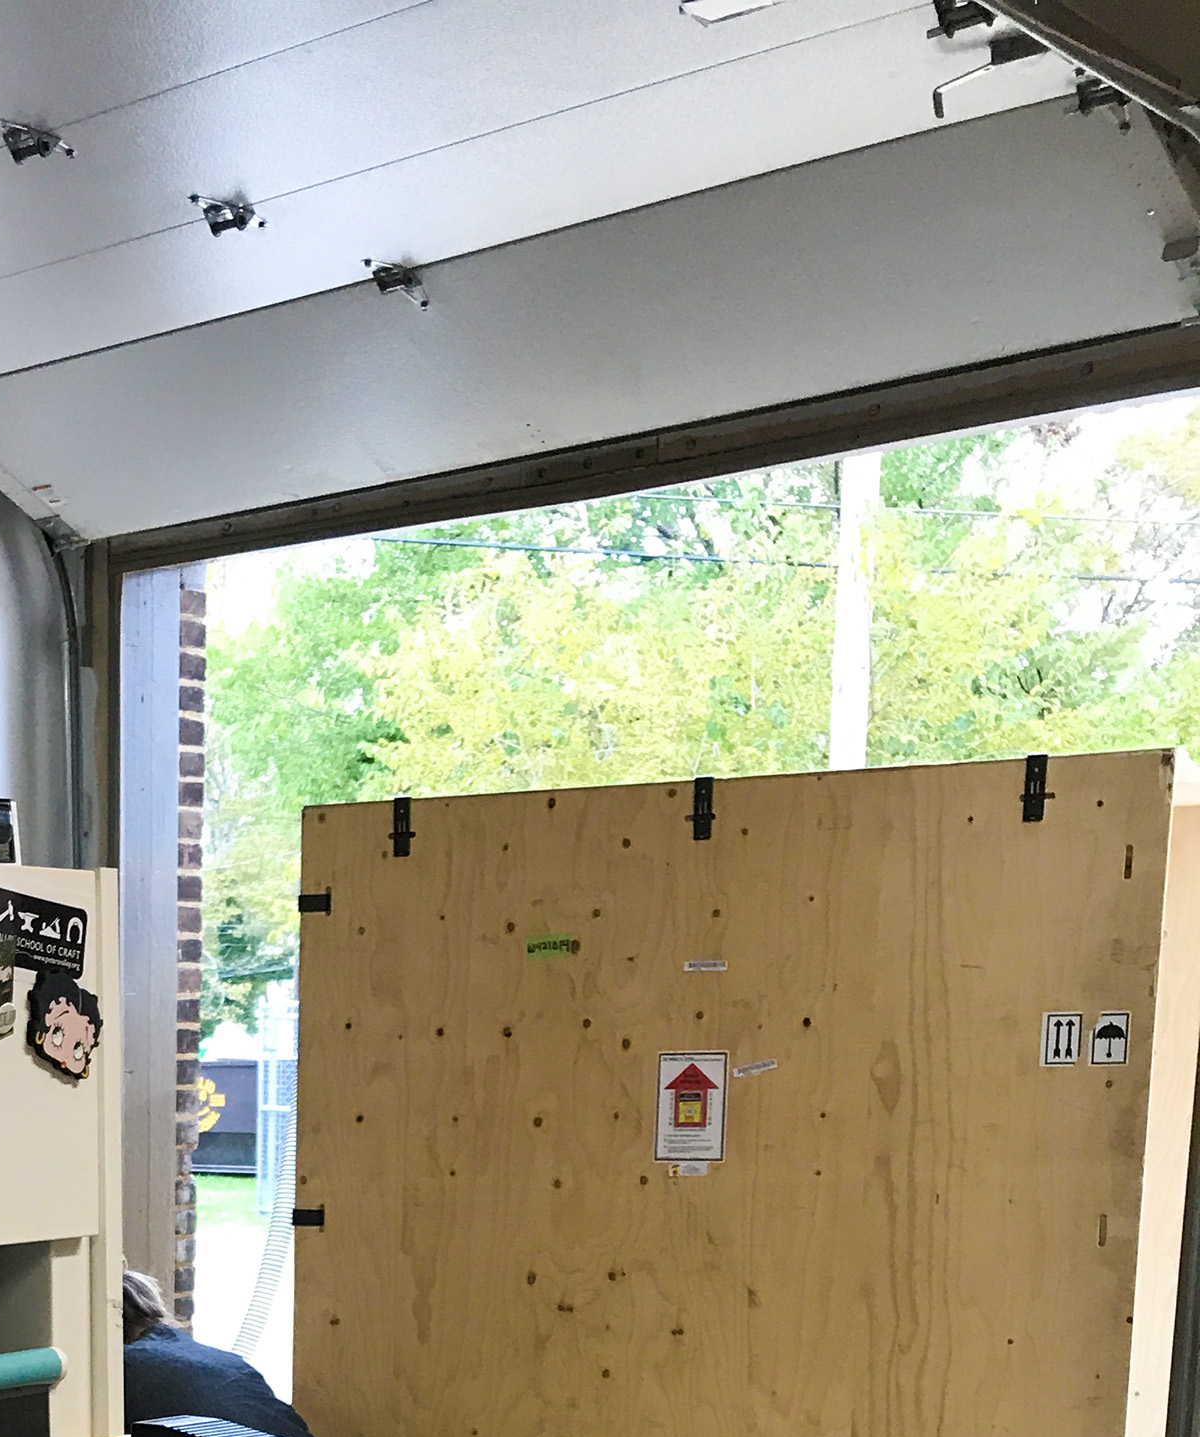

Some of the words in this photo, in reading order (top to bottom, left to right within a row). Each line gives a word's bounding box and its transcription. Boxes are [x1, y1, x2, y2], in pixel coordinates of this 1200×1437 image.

[16, 936, 45, 952] SCHOOL
[46, 944, 57, 954] OF
[57, 947, 81, 960] CRAFT
